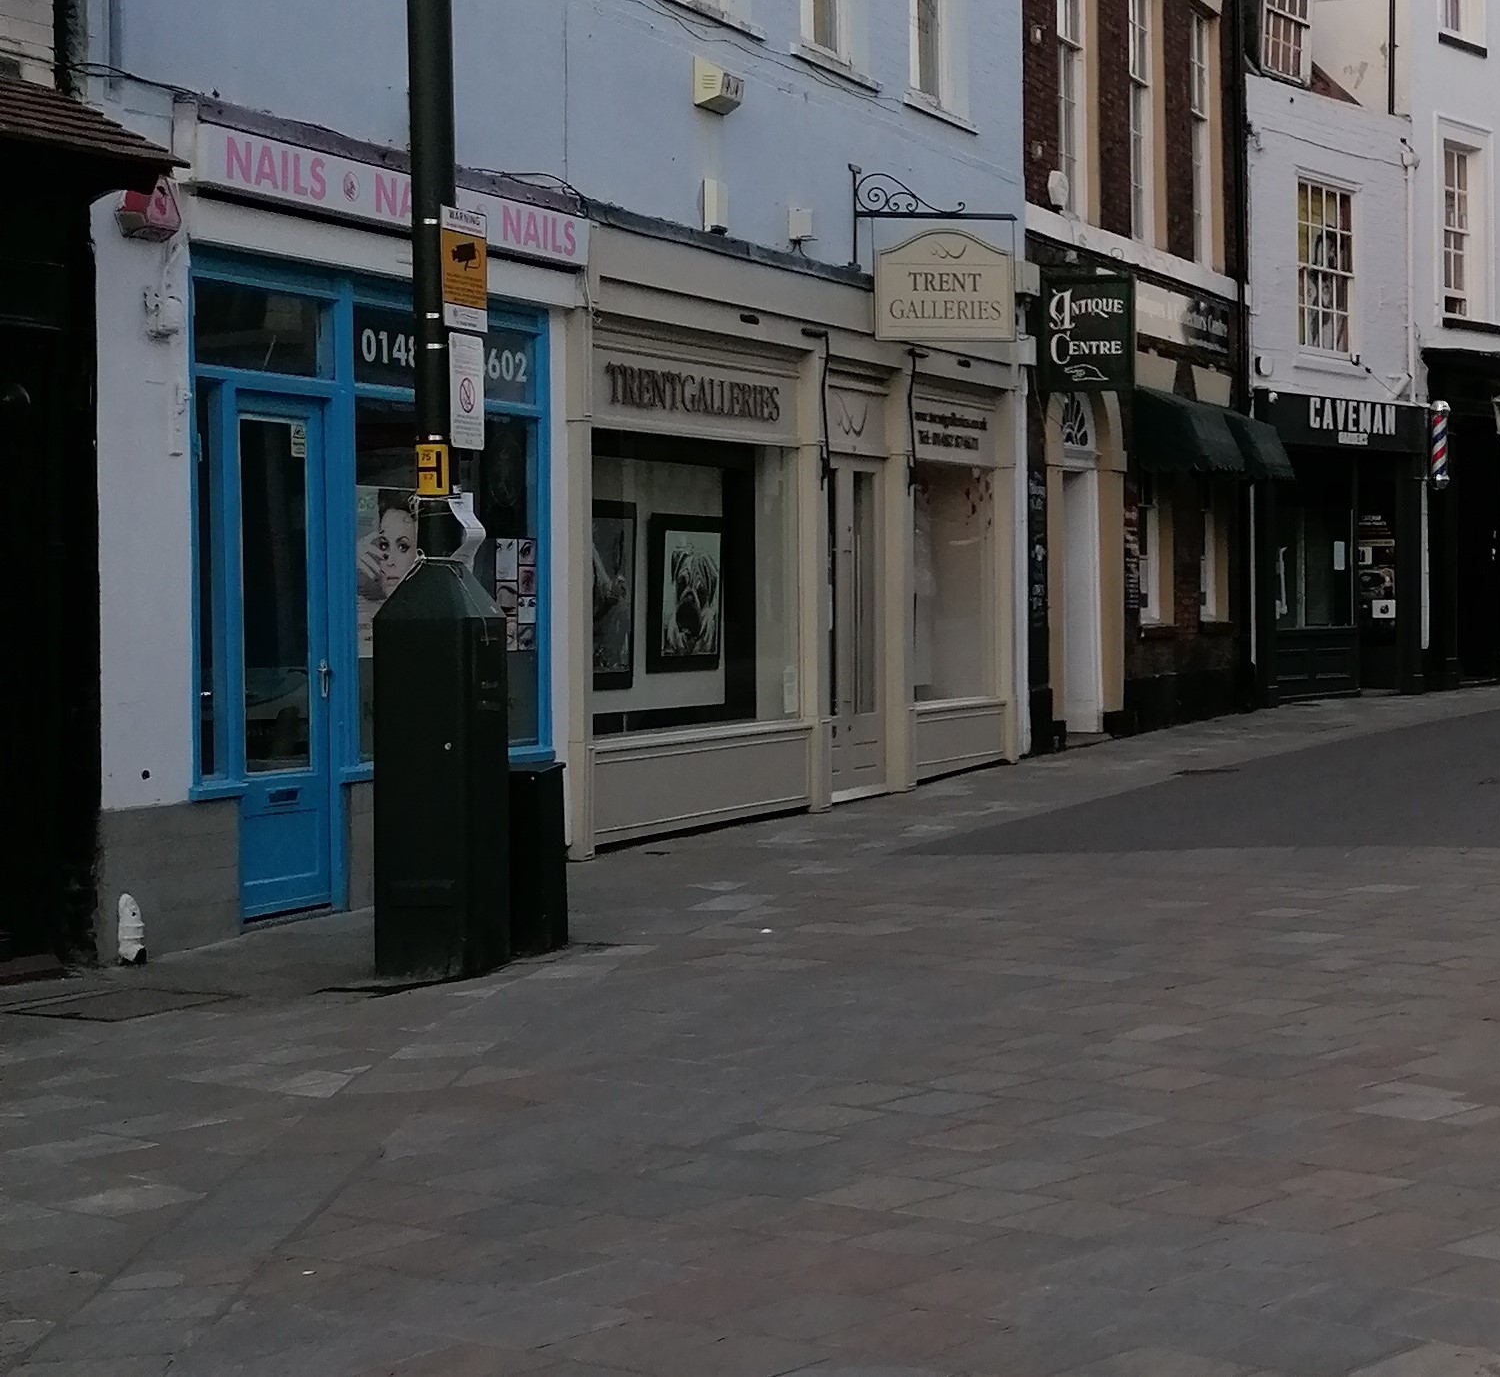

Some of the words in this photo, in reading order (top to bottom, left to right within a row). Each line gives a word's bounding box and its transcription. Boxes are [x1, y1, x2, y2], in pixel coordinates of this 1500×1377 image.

[226, 135, 327, 201] NAILS
[502, 203, 577, 258] NAILS
[907, 271, 982, 293] TRENT
[889, 299, 1001, 321] GALLERIES
[1049, 288, 1124, 330] ANTIQUE
[1050, 330, 1124, 365] CENTRE
[1309, 396, 1397, 436] CAVEMAN
